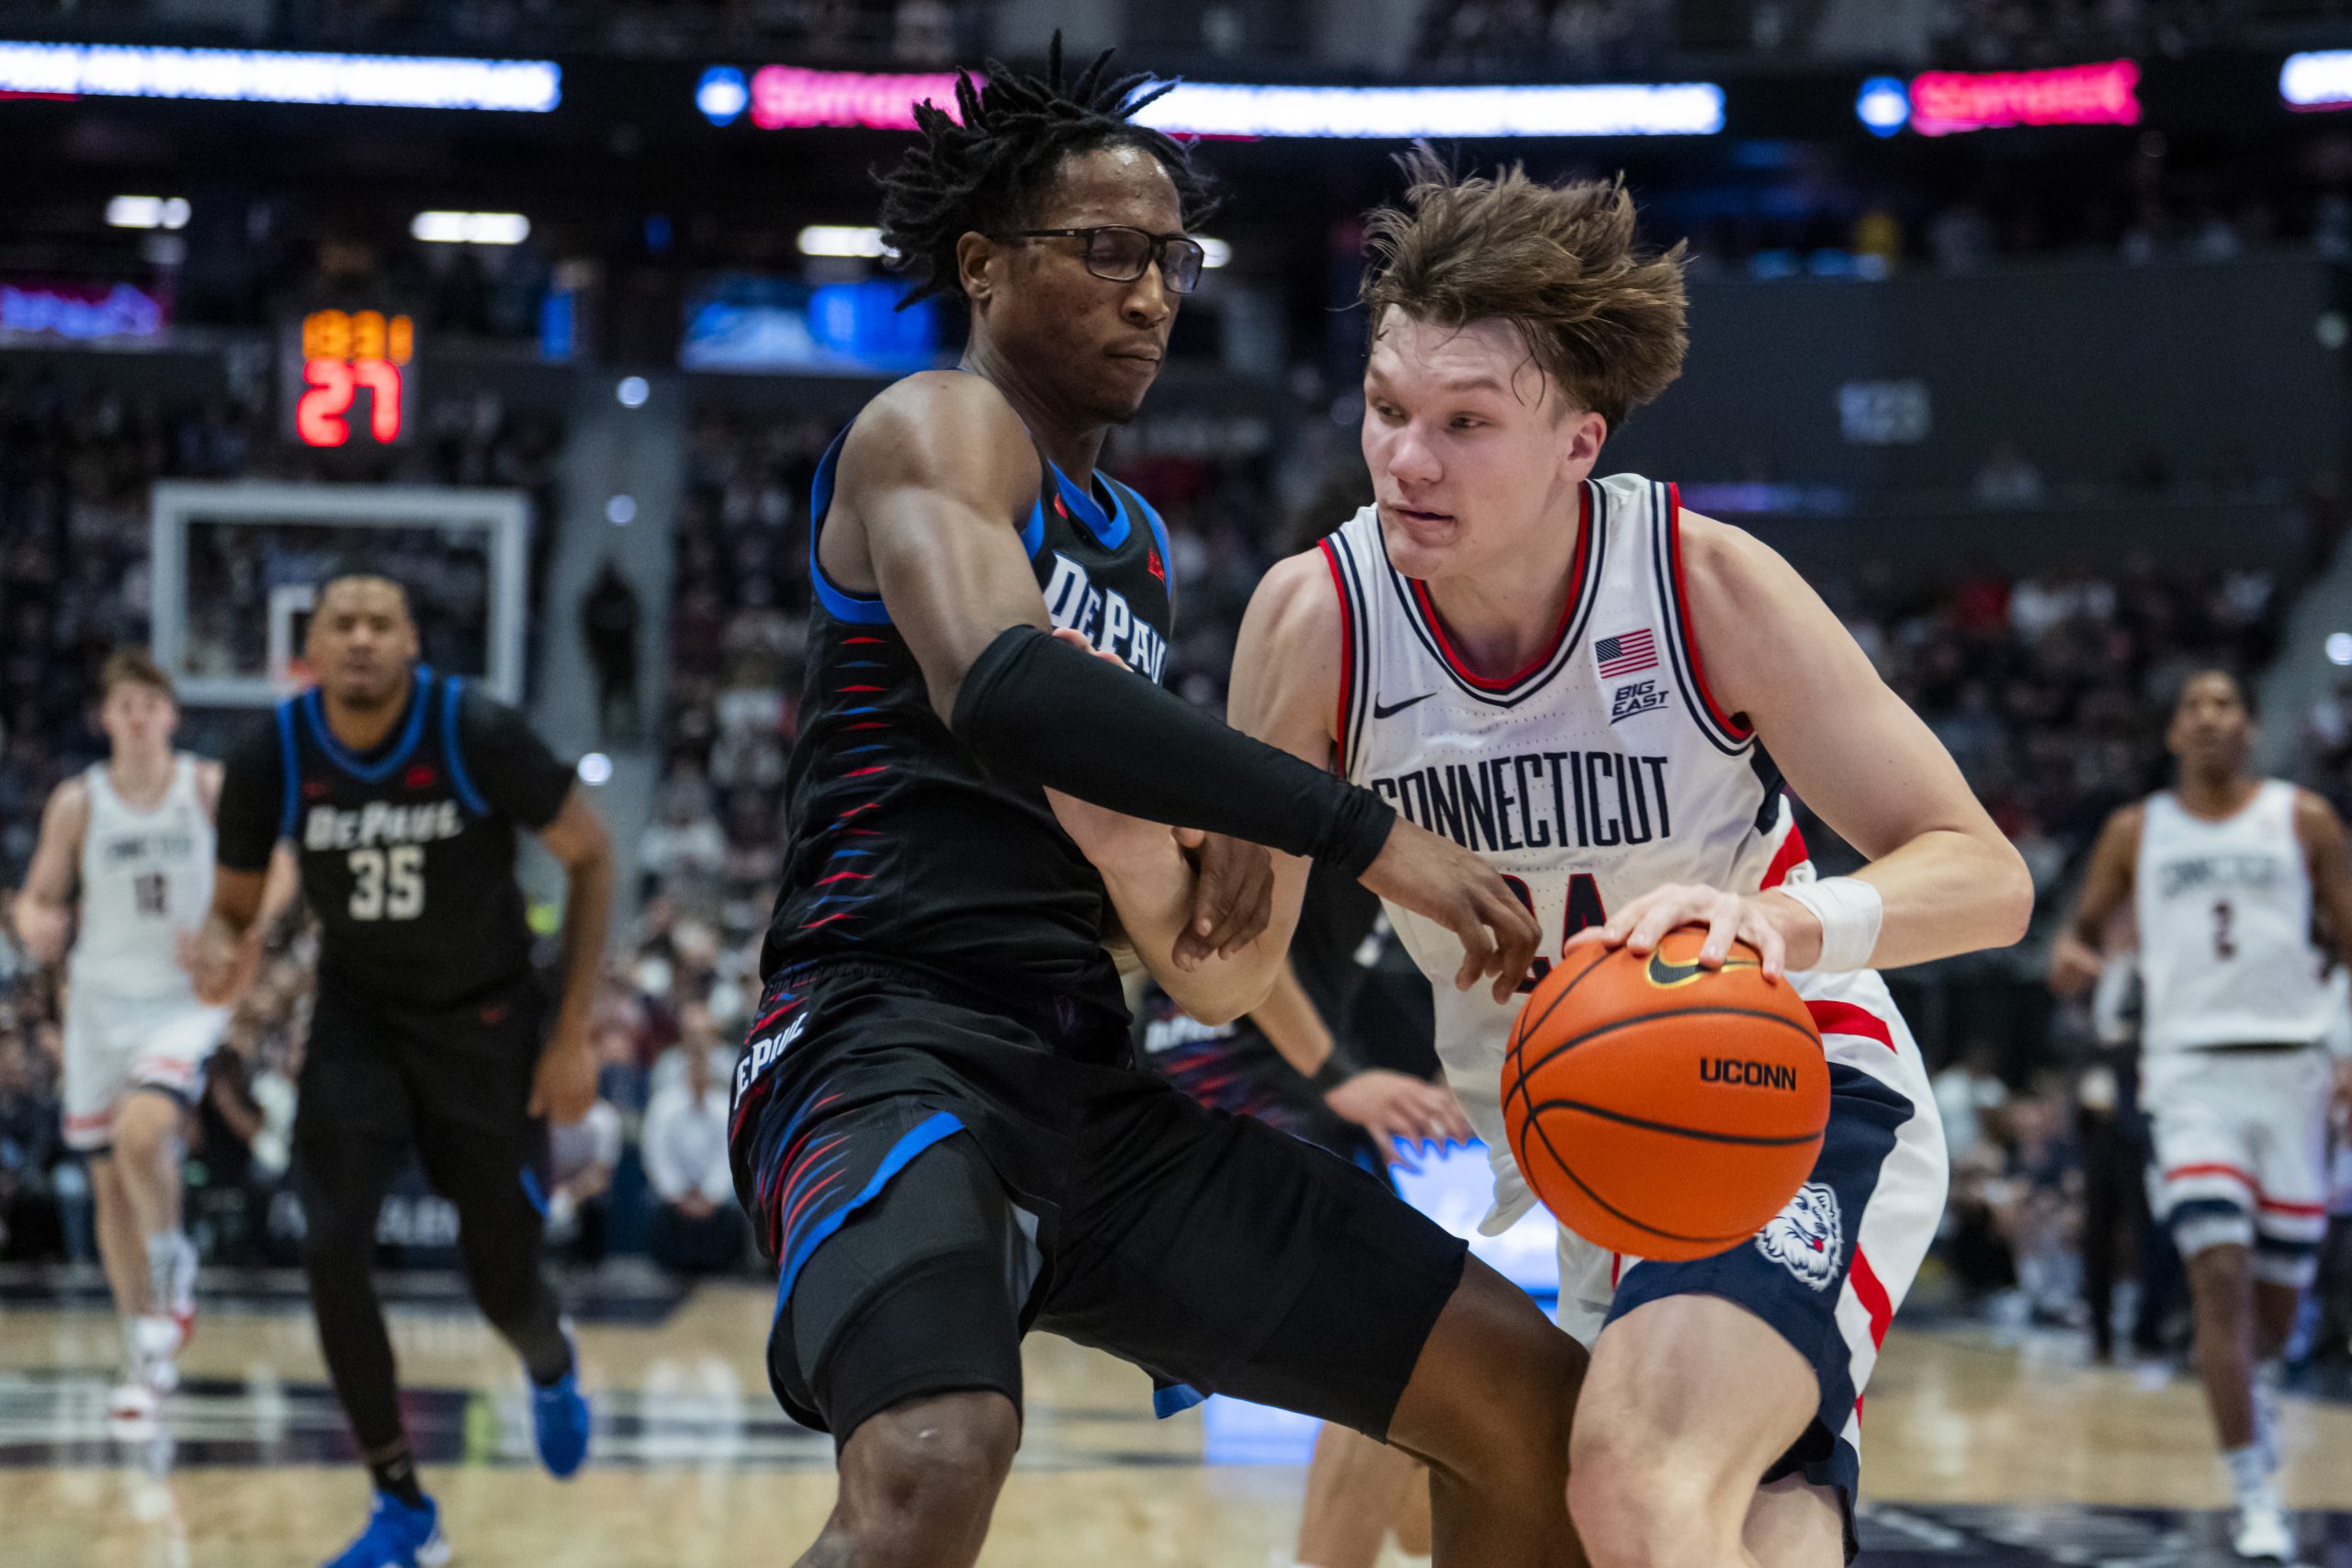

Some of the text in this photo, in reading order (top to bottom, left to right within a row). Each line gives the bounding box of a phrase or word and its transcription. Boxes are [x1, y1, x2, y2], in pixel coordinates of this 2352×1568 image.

[296, 355, 402, 447] 27
[1043, 552, 1168, 685] DEPAU
[1611, 691, 1669, 716] EAST
[1614, 680, 1656, 702] BIG
[347, 845, 426, 920] 35
[1700, 1057, 1796, 1092] UCONN
